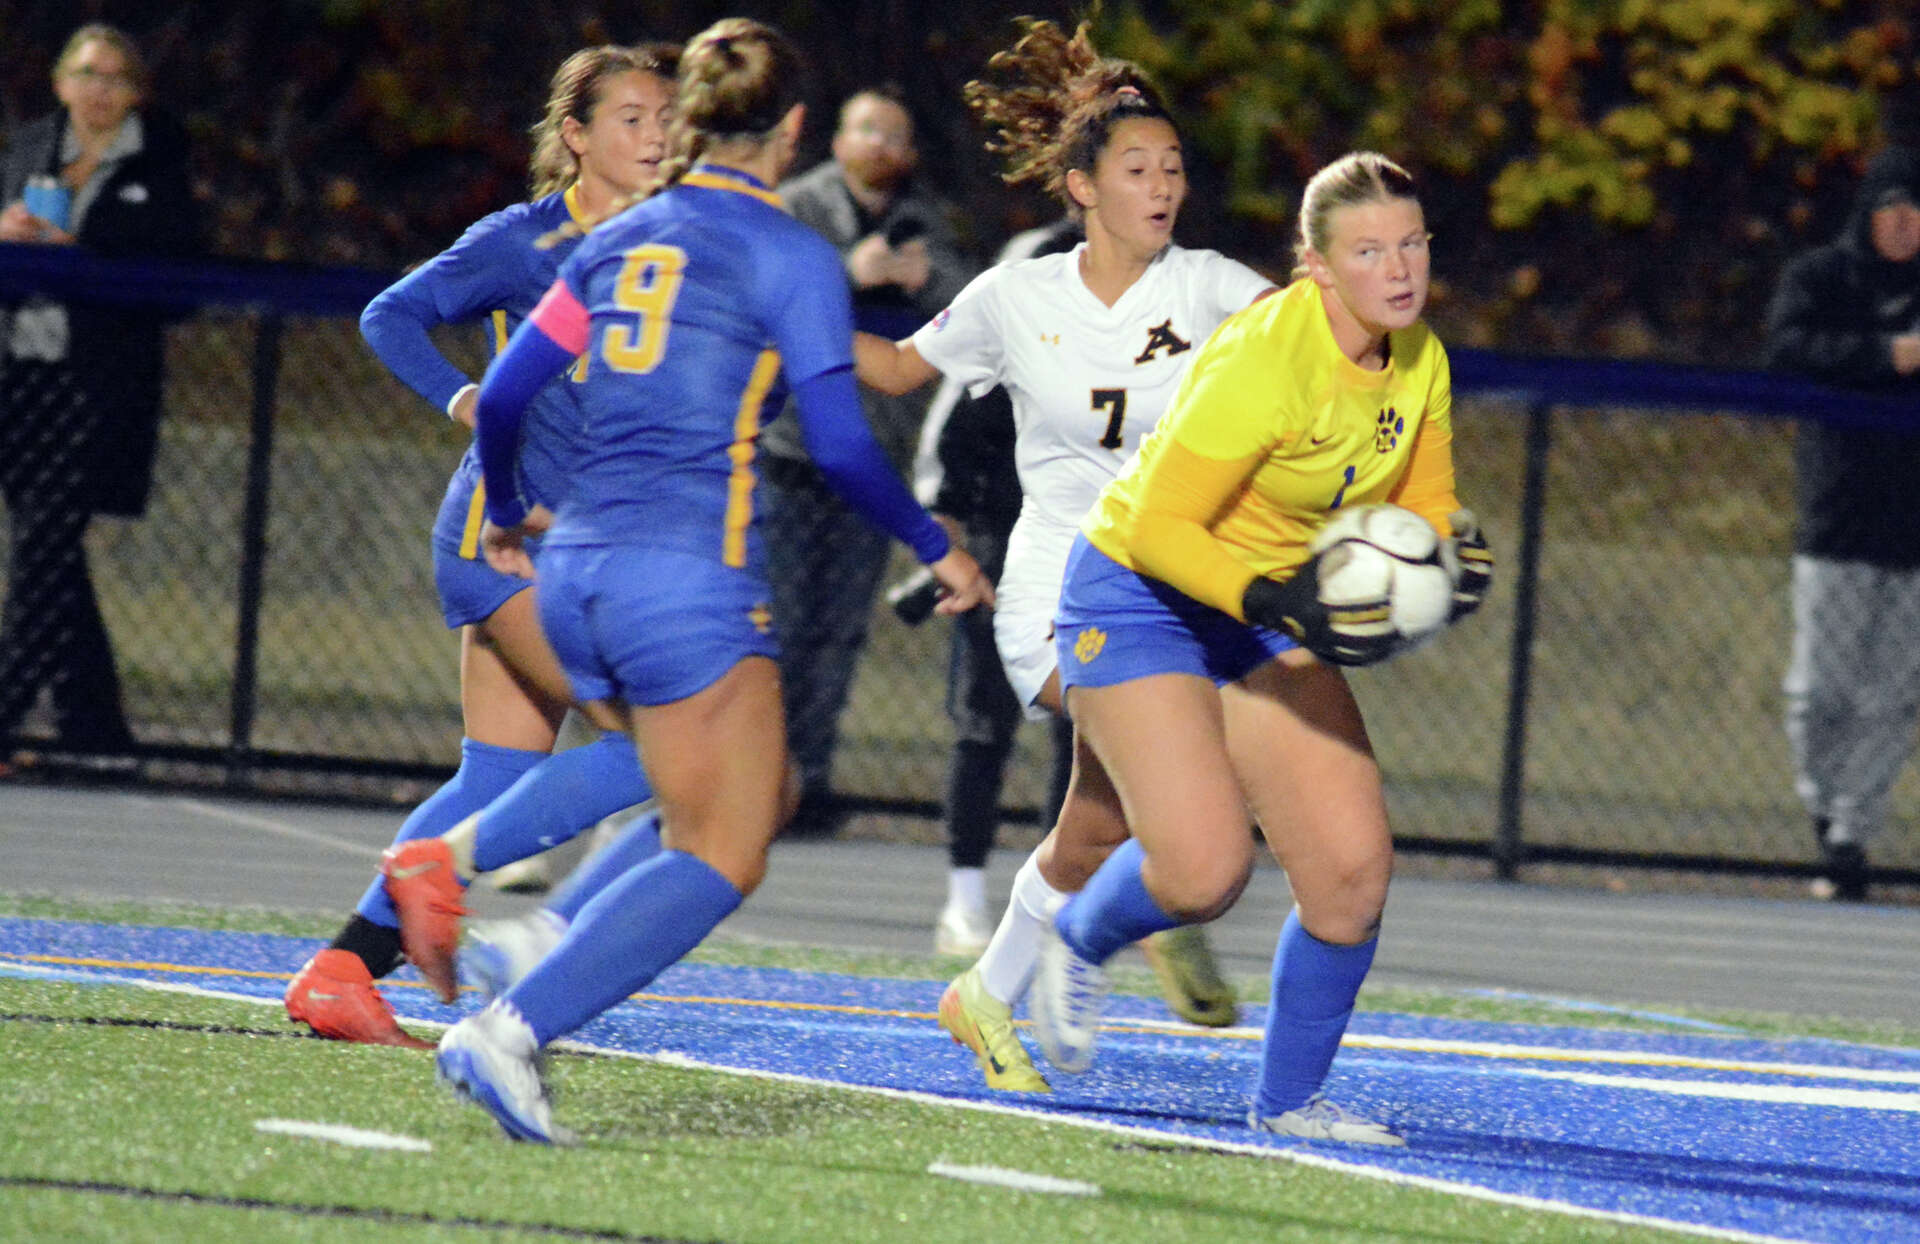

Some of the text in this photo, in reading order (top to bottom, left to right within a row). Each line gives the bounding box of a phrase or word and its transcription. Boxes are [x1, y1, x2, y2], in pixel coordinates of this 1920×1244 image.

[602, 243, 688, 374] 9
[1134, 318, 1191, 365] A
[1090, 388, 1128, 450] 7
[1330, 465, 1356, 510] 1
